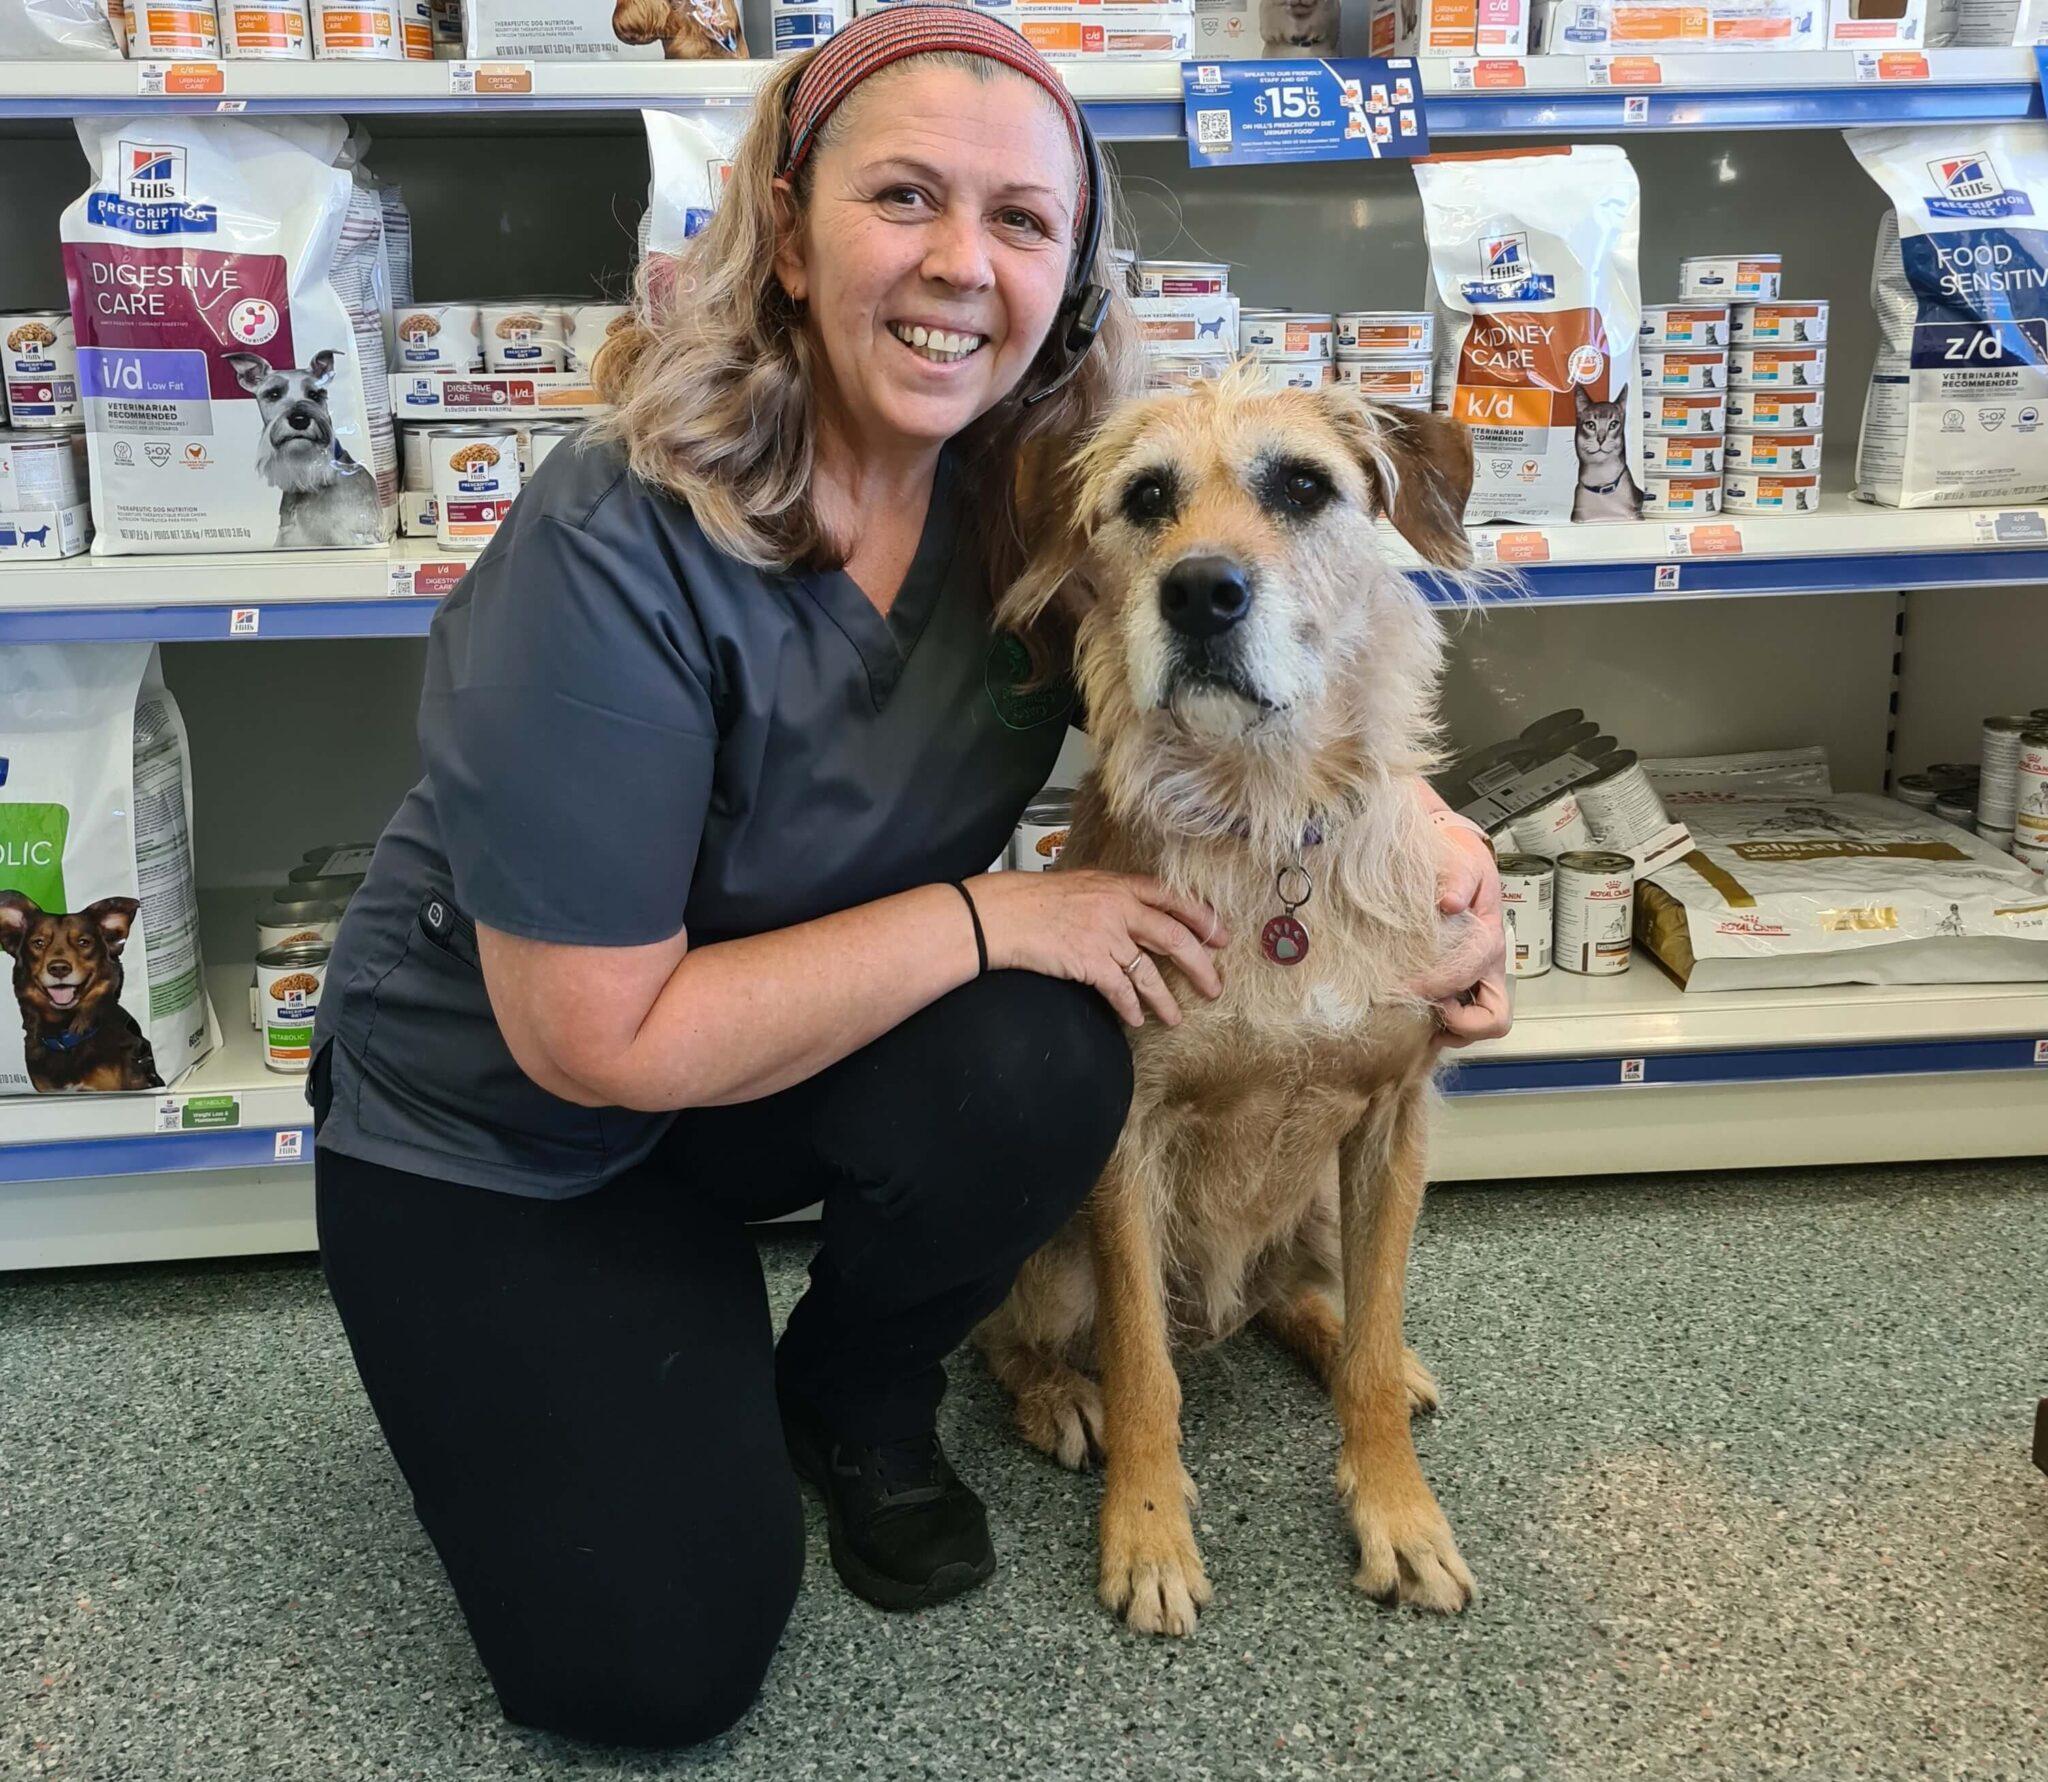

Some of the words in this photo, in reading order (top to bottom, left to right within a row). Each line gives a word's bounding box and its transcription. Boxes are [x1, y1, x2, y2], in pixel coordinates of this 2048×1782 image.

[1435, 5, 1468, 13] URINARY
[1435, 14, 1455, 22] CARE
[1305, 86, 1321, 117] OFF
[131, 182, 175, 198] Hill's
[1949, 182, 1993, 198] Hill's
[1933, 195, 2025, 209] PRESCRIPTION
[98, 200, 208, 221] PRESCRIPTION
[1968, 207, 1997, 216] DIET
[135, 219, 169, 230] DIET
[1938, 245, 2013, 270] FOOD
[92, 262, 238, 289] DIGESTIVE
[1490, 265, 1525, 281] Hill's
[98, 292, 165, 315] CARE
[1474, 325, 1555, 345] KIDNEY
[1944, 330, 2003, 360] z/d
[1472, 349, 1535, 369] CARE
[102, 357, 143, 390] i/d
[147, 381, 166, 391] Low
[168, 381, 184, 391] Fat
[1943, 371, 2019, 380] VETERINARIAN
[447, 384, 491, 392] DIGESTIVE
[1942, 379, 2018, 388] RECOMMENDED
[108, 402, 176, 412] VETERINARIAN
[1468, 393, 1514, 418] k/d
[108, 411, 177, 420] RECOMMENDED
[1590, 890, 1612, 898] ROYAL
